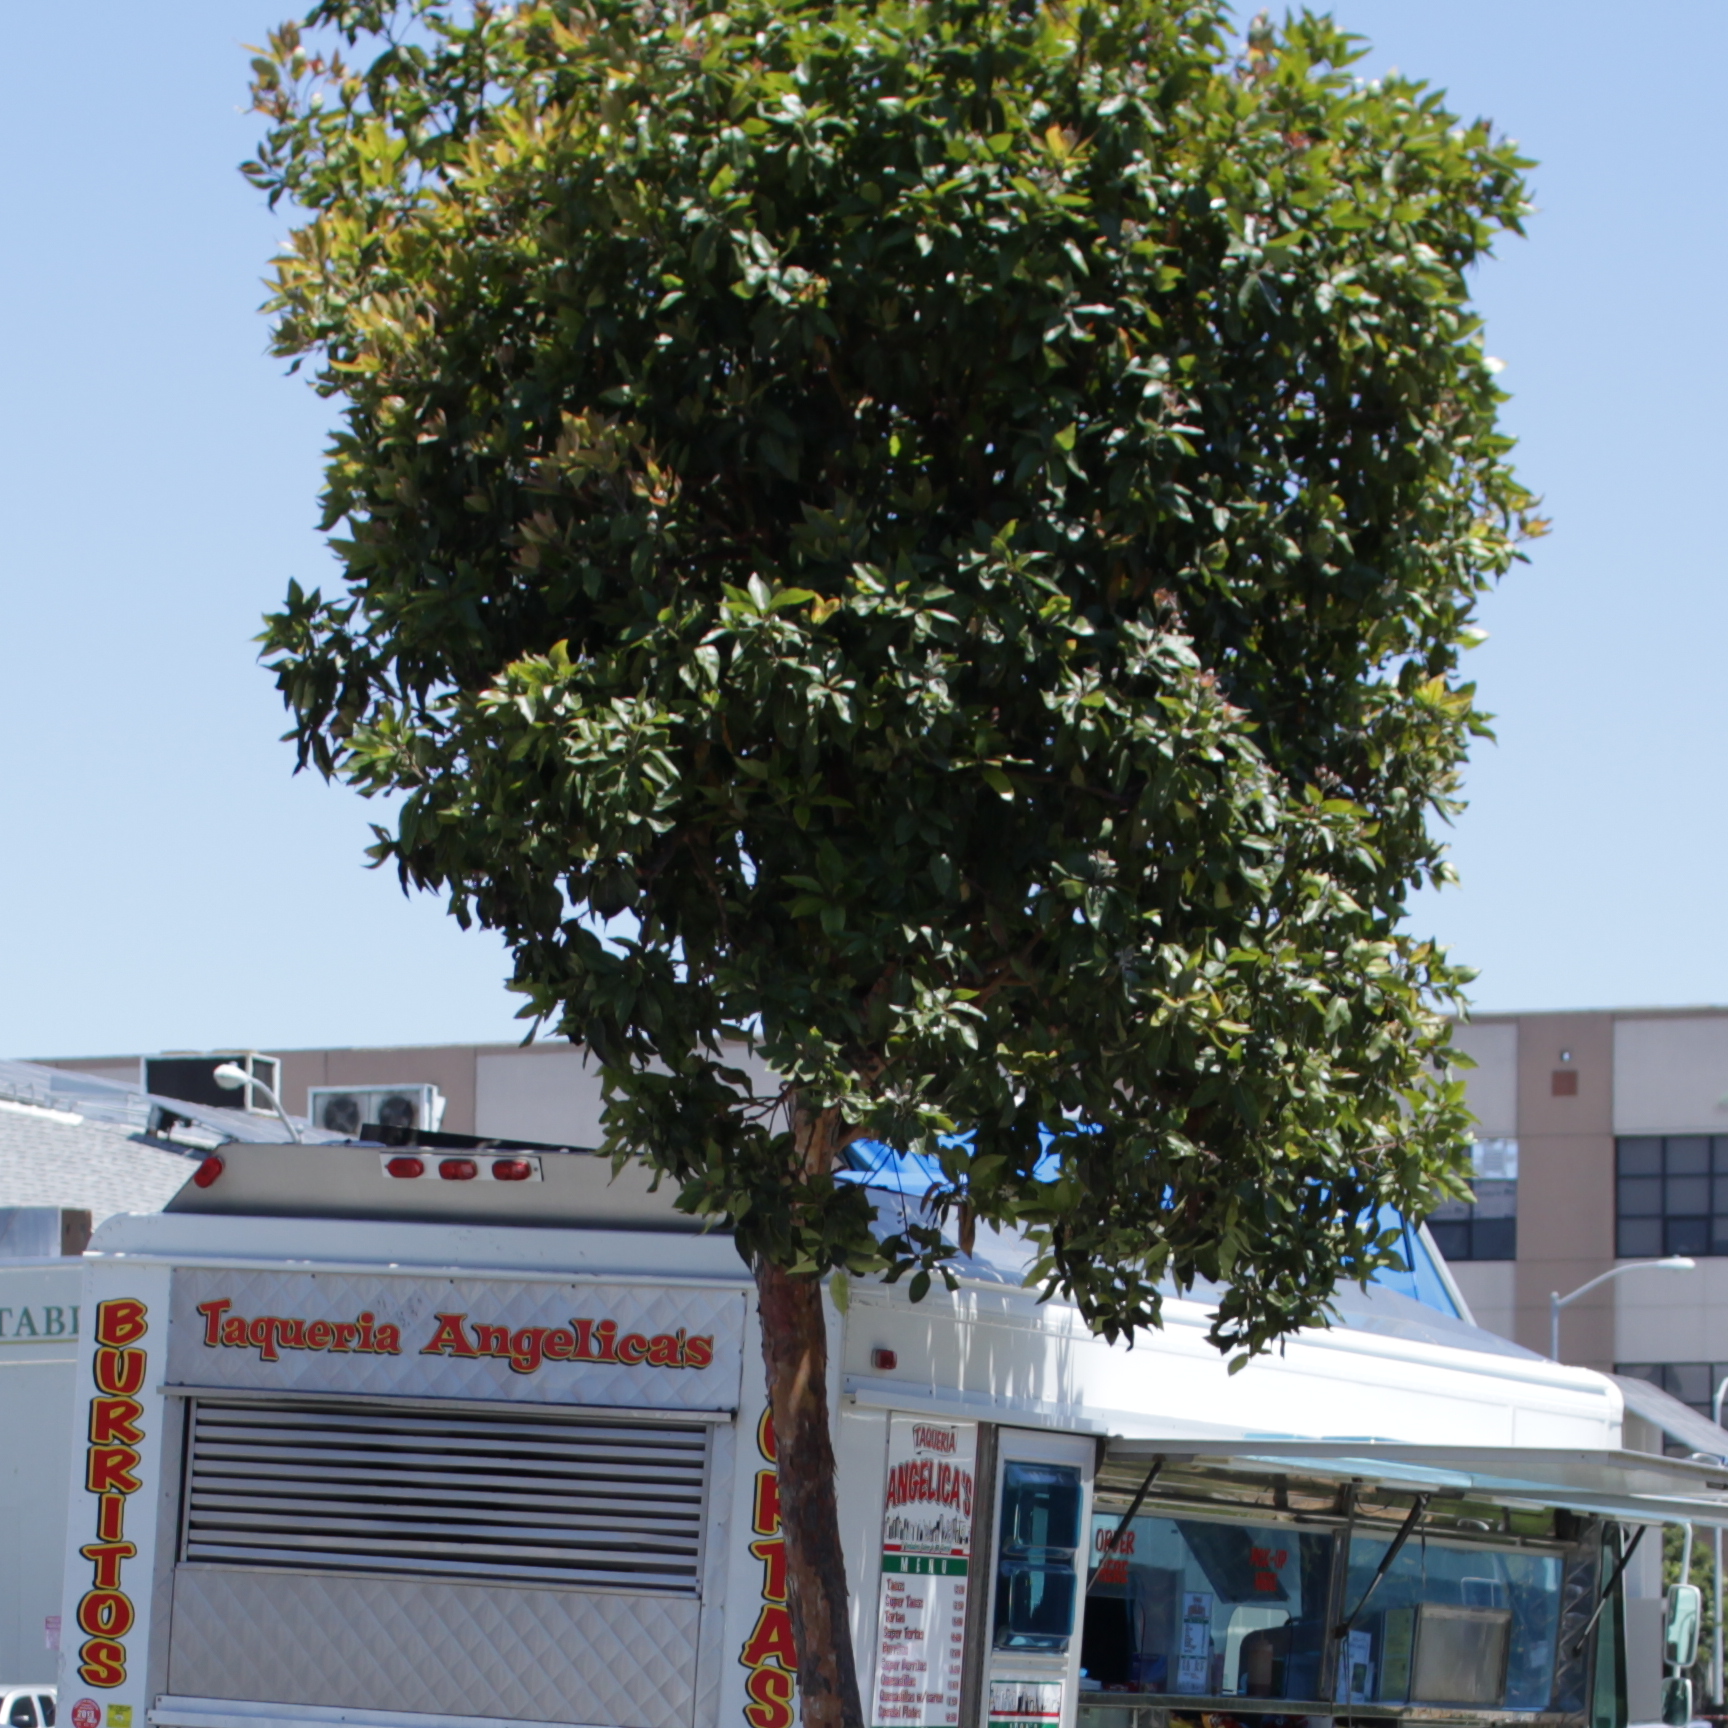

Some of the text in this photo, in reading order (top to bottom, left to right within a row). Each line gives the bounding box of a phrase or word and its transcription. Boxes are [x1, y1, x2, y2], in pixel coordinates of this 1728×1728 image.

[198, 1297, 715, 1374] Taqueria Angelica's
[914, 1427, 956, 1453] TAQUERIA
[76, 1297, 148, 1688] BURRITOS
[886, 1458, 972, 1520] ANGELICA'S
